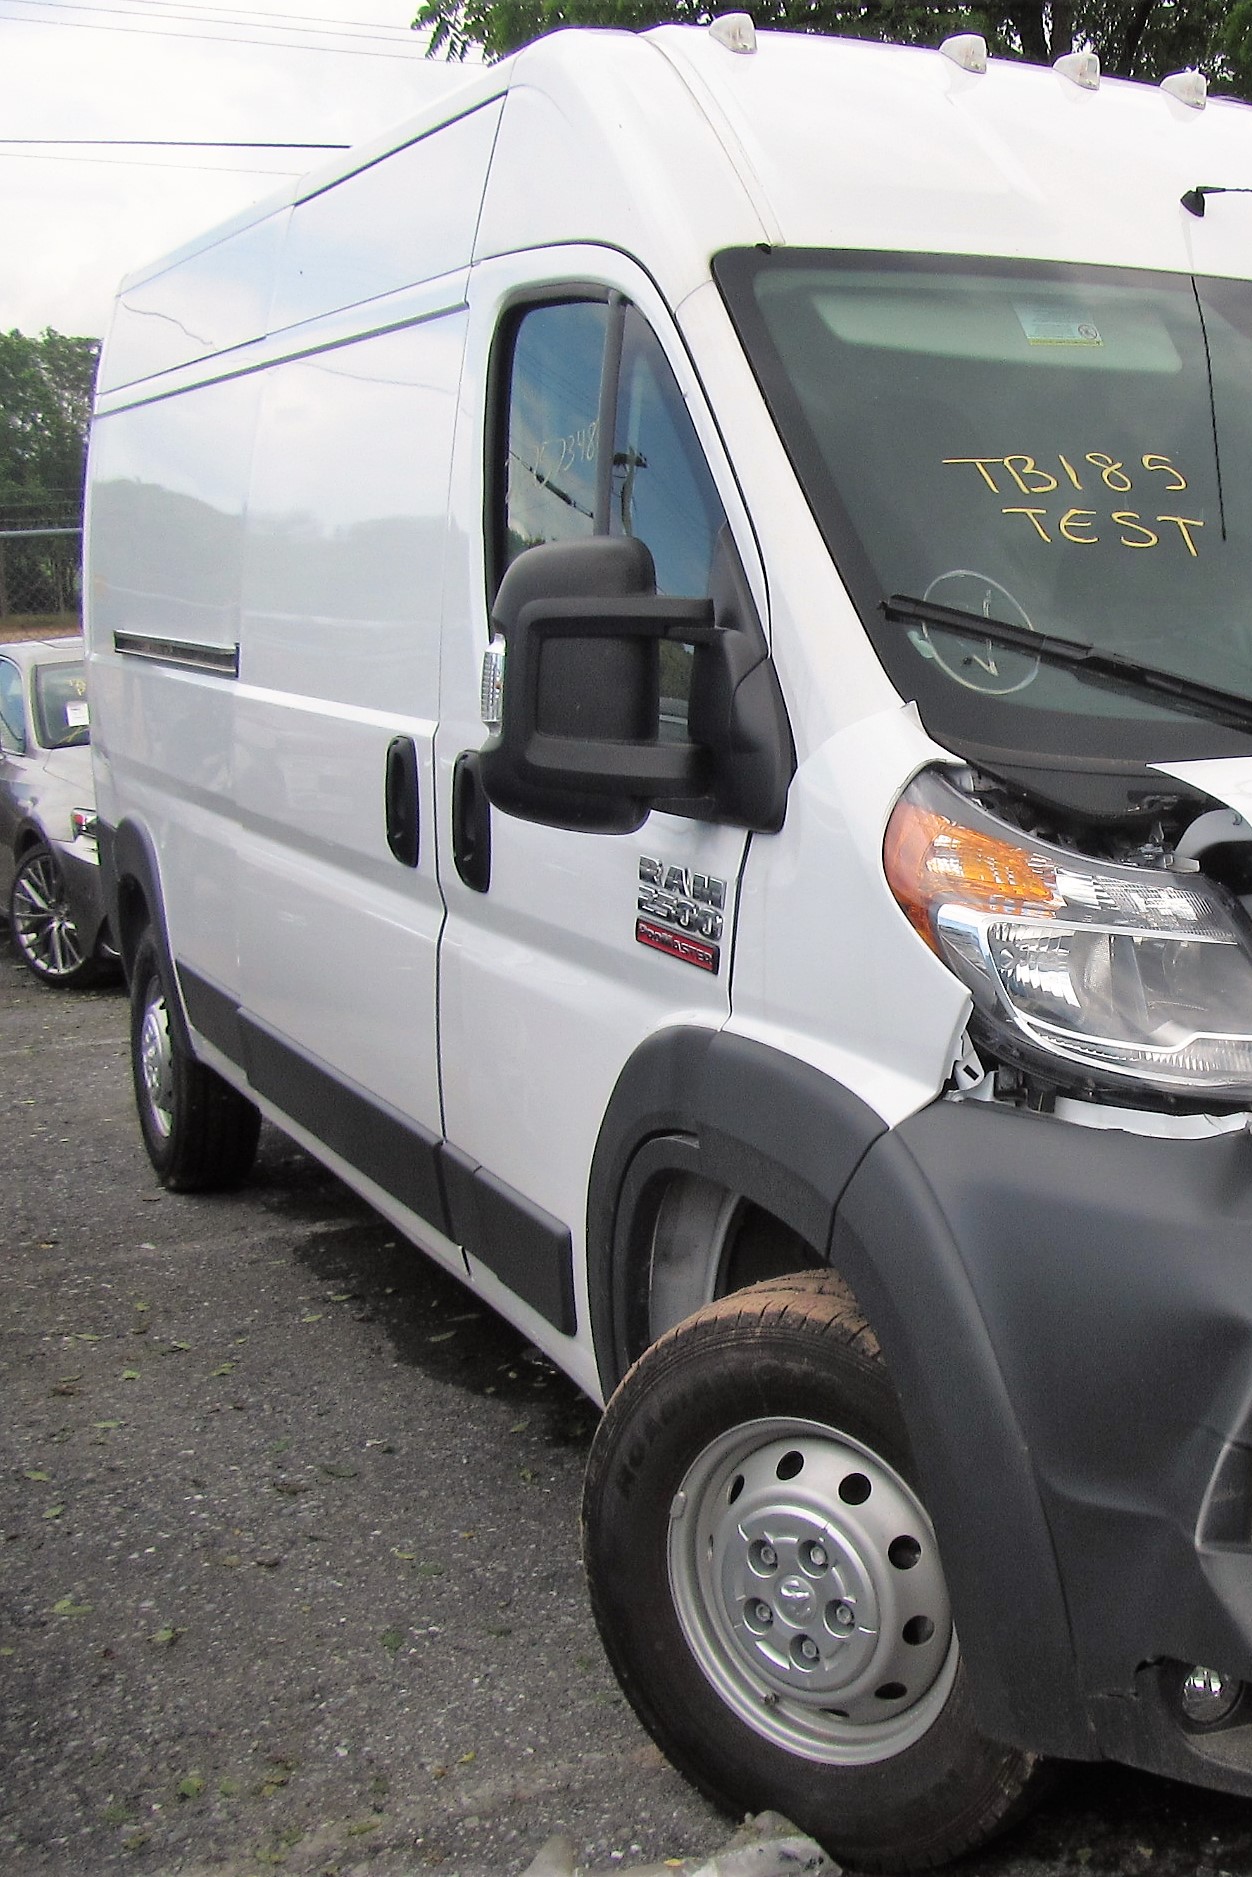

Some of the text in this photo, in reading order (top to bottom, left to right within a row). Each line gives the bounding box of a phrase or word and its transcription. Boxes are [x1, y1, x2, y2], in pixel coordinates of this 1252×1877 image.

[942, 451, 1187, 494] TB185
[1001, 507, 1204, 557] TEST
[638, 854, 727, 911] RAM
[637, 884, 724, 941] 2500
